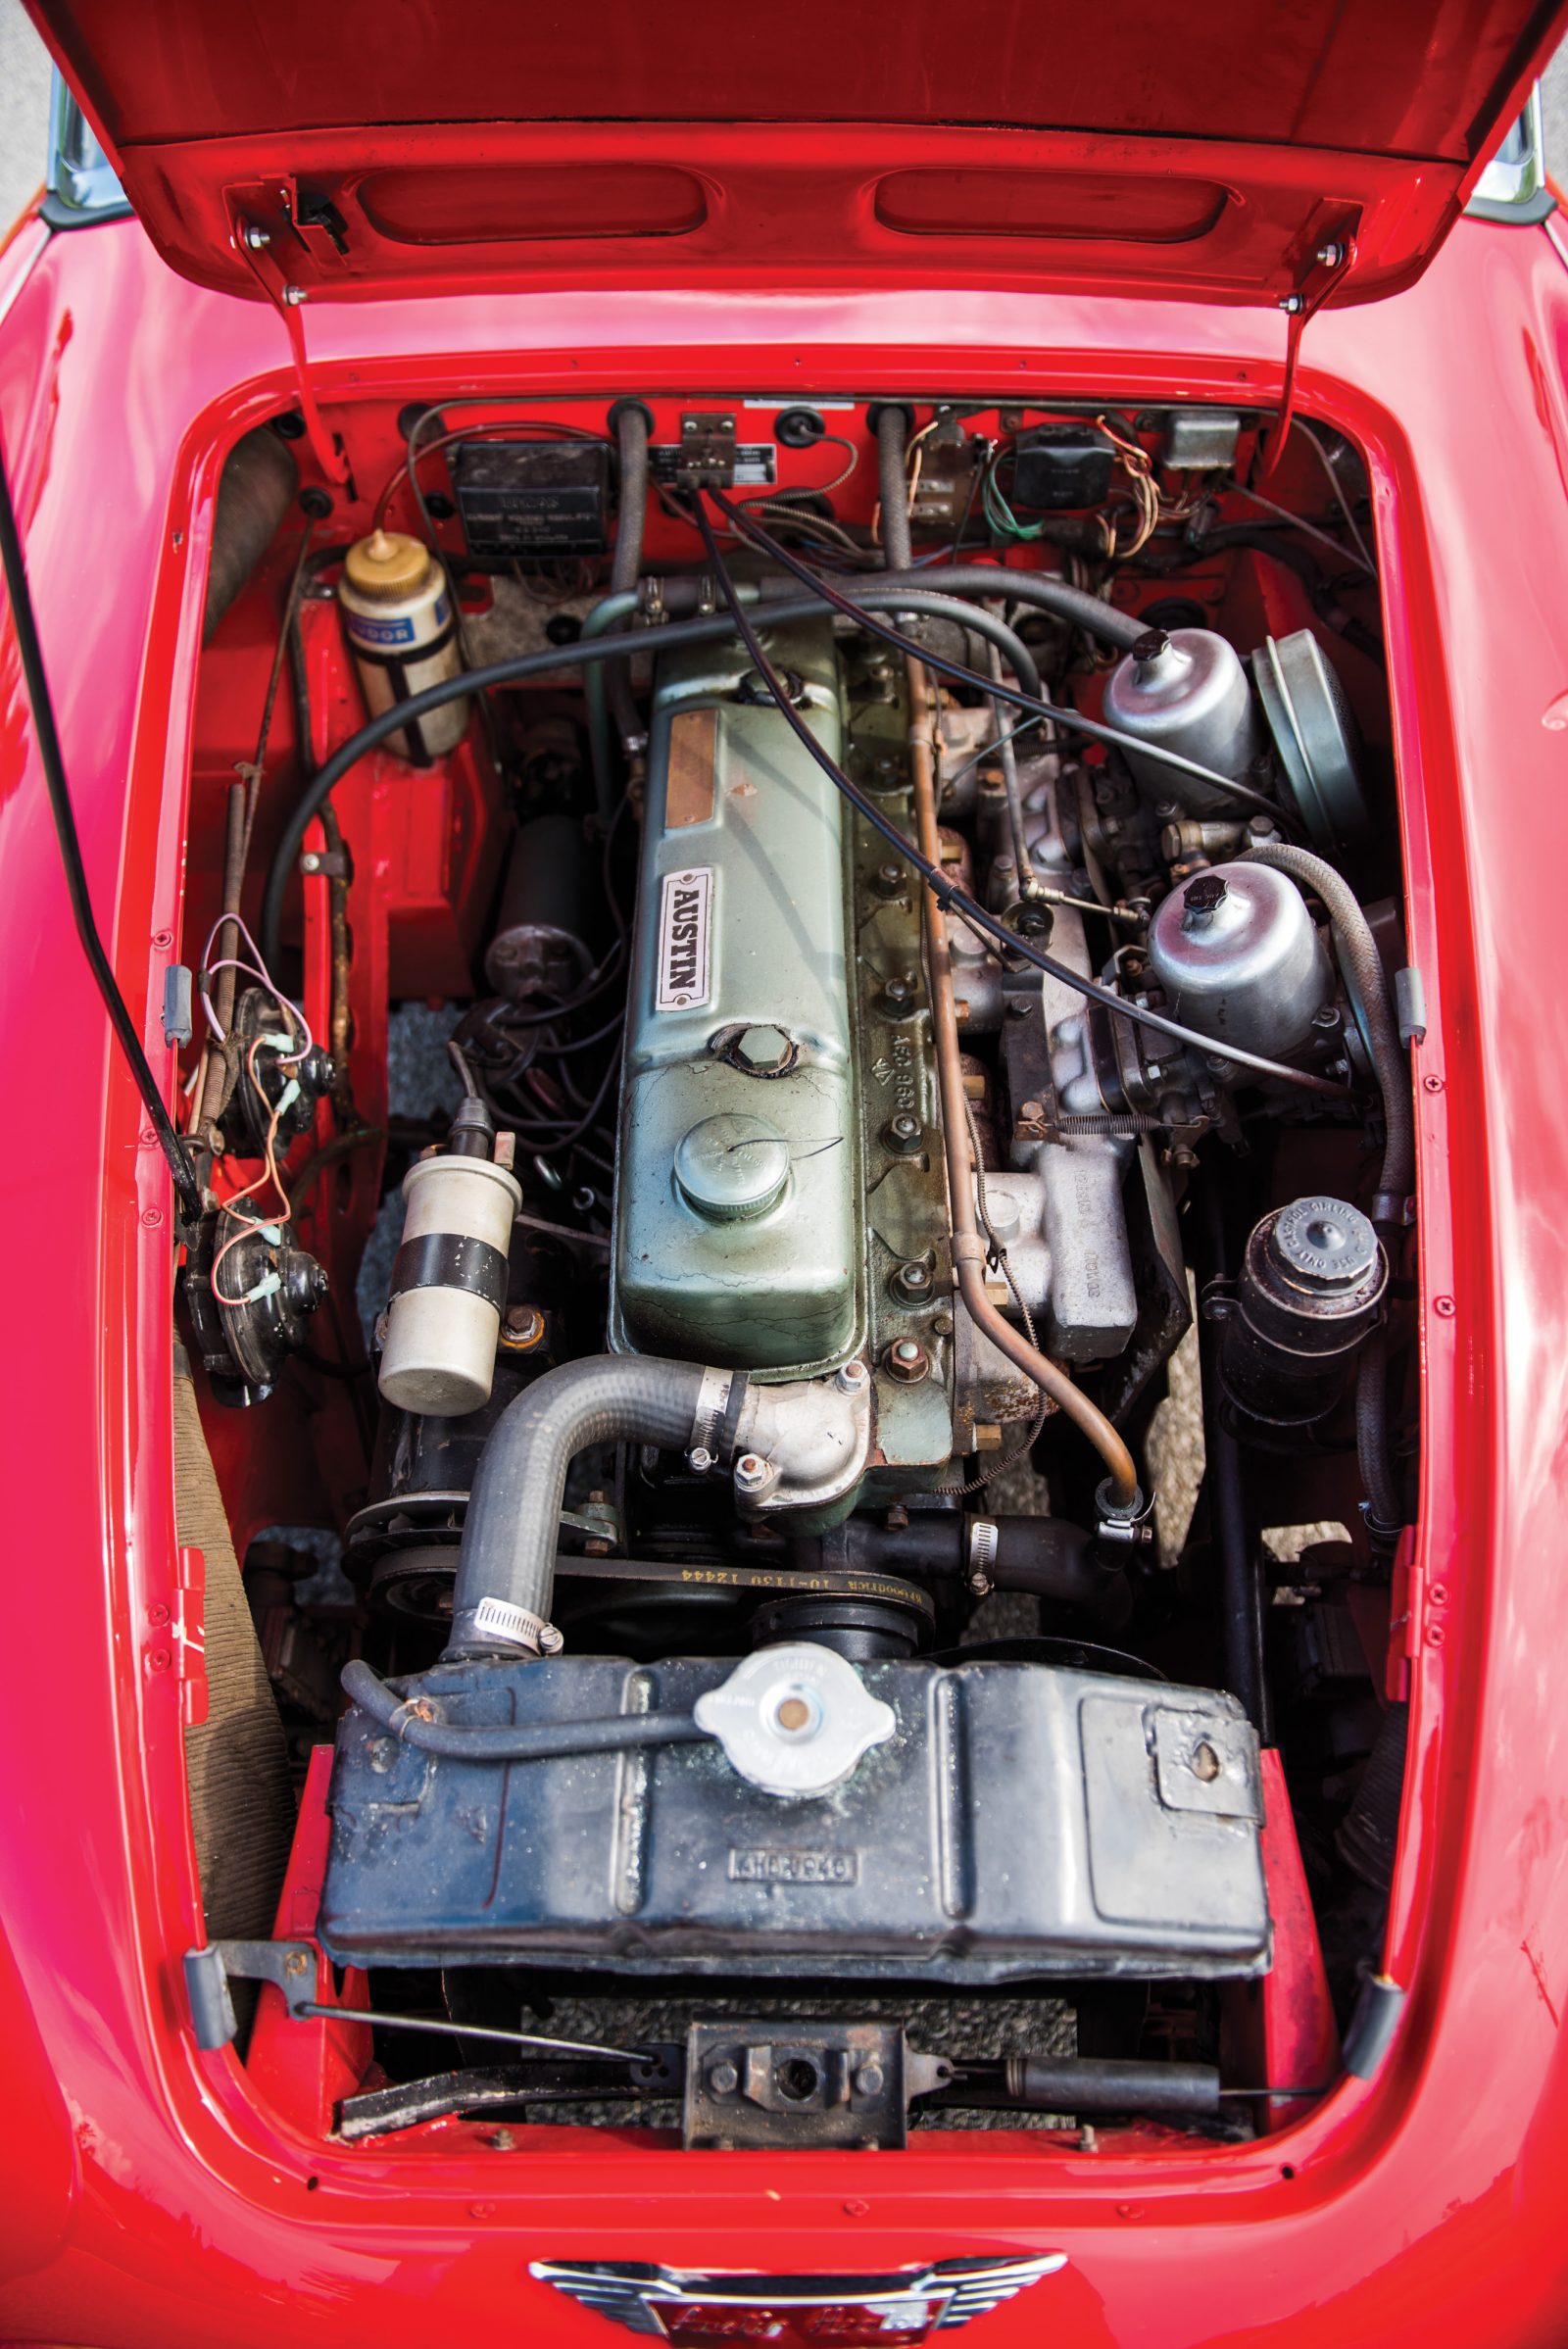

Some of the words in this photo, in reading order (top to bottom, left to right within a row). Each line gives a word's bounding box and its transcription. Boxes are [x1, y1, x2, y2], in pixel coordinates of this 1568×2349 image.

[669, 890, 700, 990] AUSTIN
[895, 1074, 915, 1109] 960
[1309, 1201, 1358, 1224] GIRLING
[1298, 1250, 1327, 1269] ONLY
[1331, 1255, 1355, 1270] USE
[681, 1568, 738, 1585] 12444
[751, 1576, 831, 1590] 10-1130
